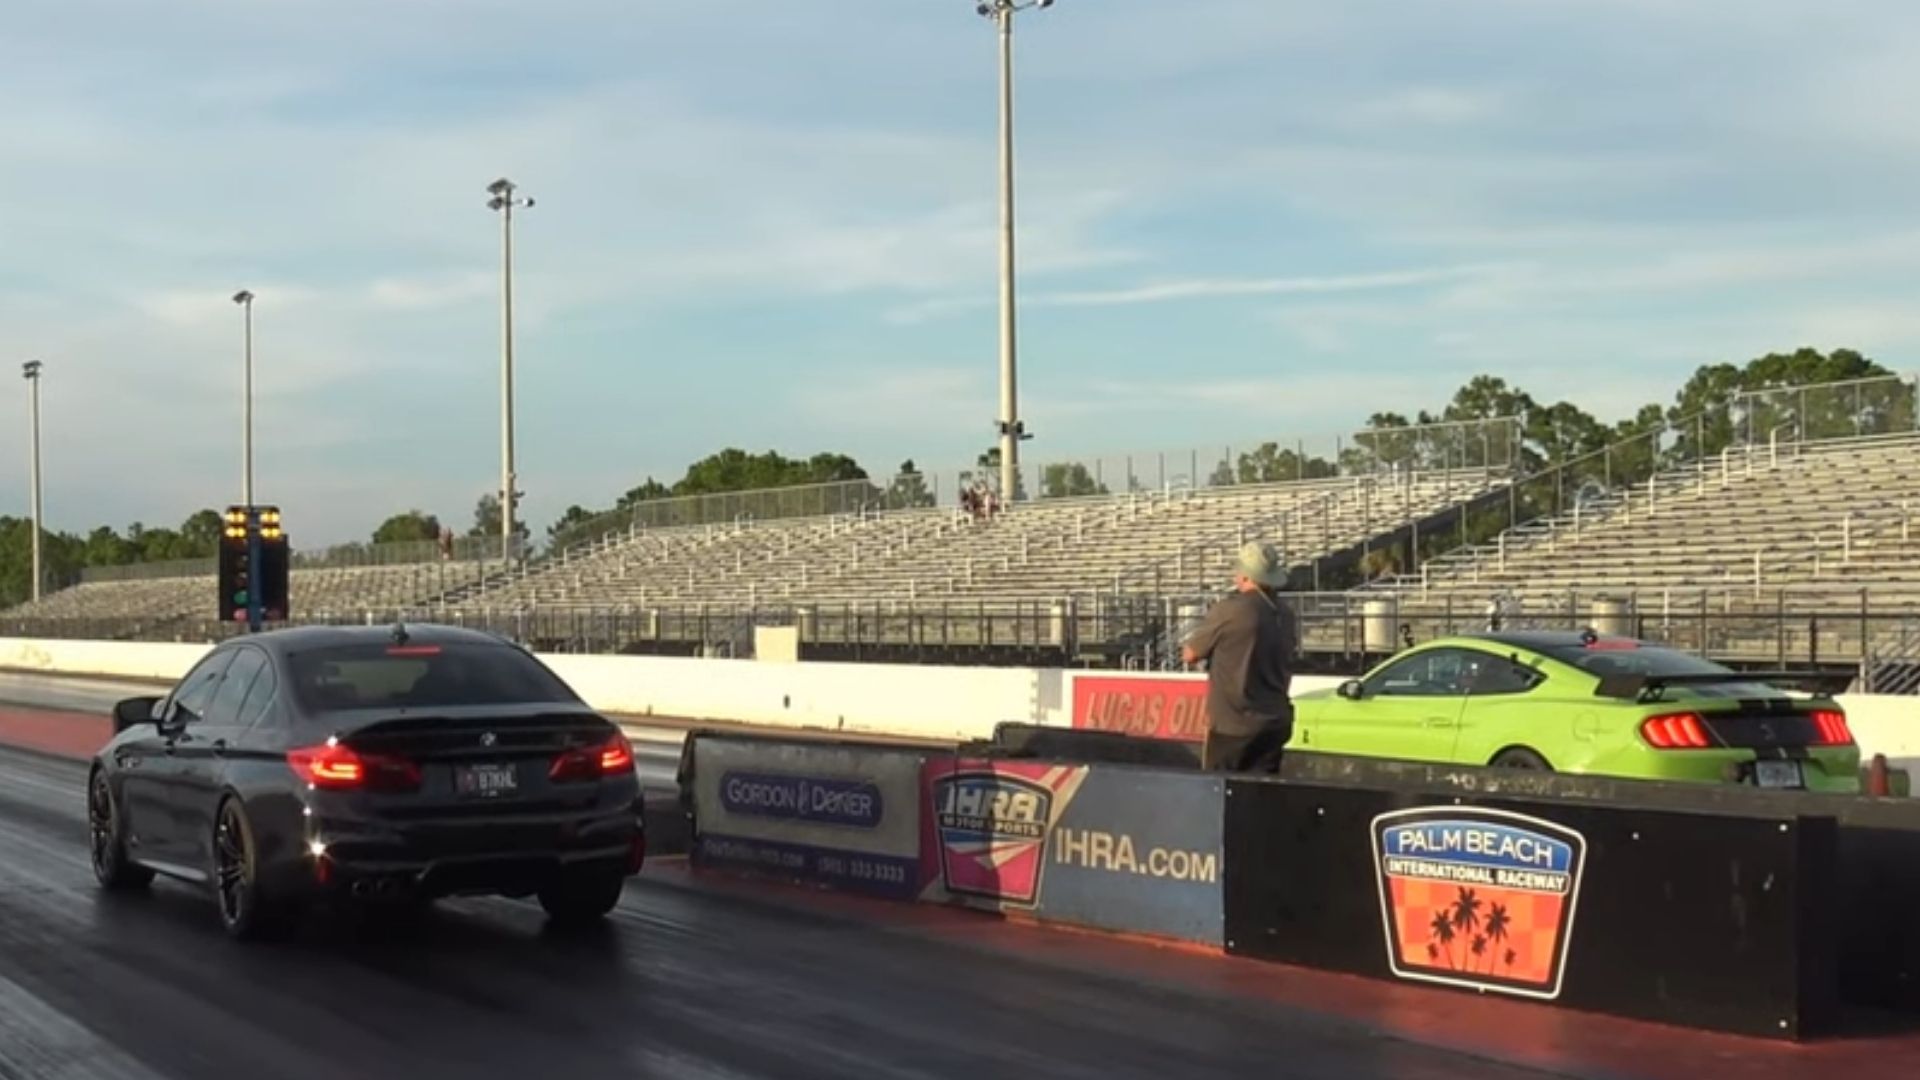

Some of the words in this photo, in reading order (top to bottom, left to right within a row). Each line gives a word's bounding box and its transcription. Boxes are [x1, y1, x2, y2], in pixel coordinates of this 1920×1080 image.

[1084, 691, 1164, 736] LUCAS
[1168, 693, 1211, 738] OIL
[727, 778, 796, 809] GORDON
[940, 782, 1038, 823] IHRA
[1056, 827, 1217, 884] IHRA.COM
[1398, 828, 1461, 853] PALM
[1465, 828, 1553, 869] BEACH
[1389, 859, 1494, 884] INTERNATIONAL
[1496, 869, 1566, 891] RACEWAY
